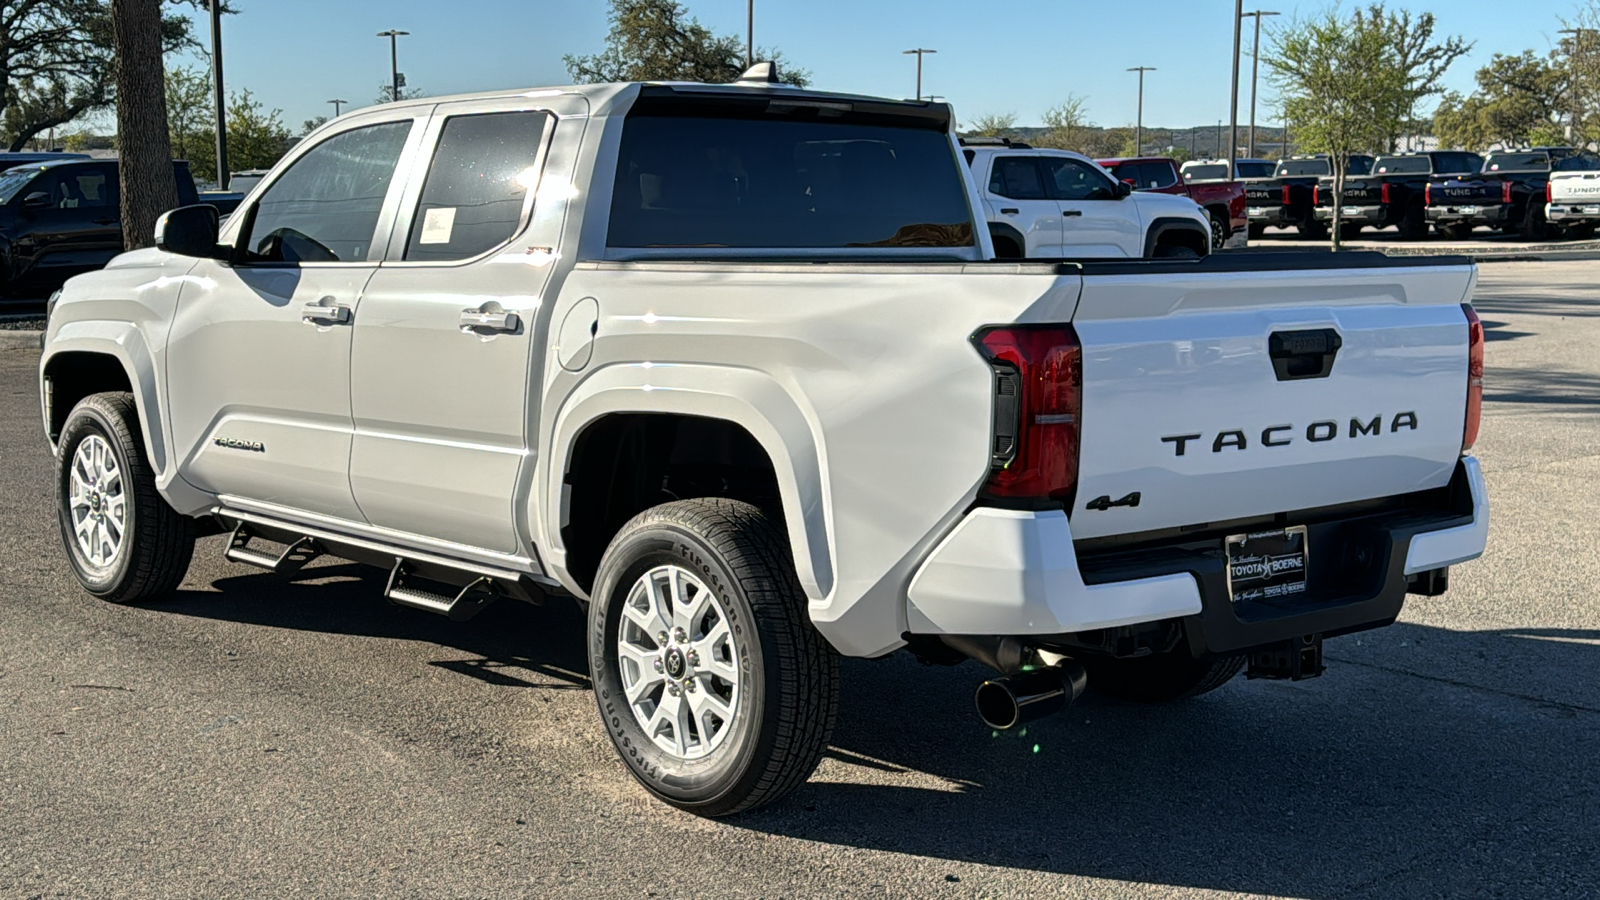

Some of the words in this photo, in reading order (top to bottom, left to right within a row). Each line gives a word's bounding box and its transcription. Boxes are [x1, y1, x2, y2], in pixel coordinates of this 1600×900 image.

[212, 437, 264, 453] TACOMA
[1161, 410, 1417, 456] TACOMA
[677, 543, 743, 636] Firestone
[1231, 563, 1262, 577] TOYOTA
[1272, 556, 1303, 571] BOERNE
[601, 686, 658, 780] Firestone
